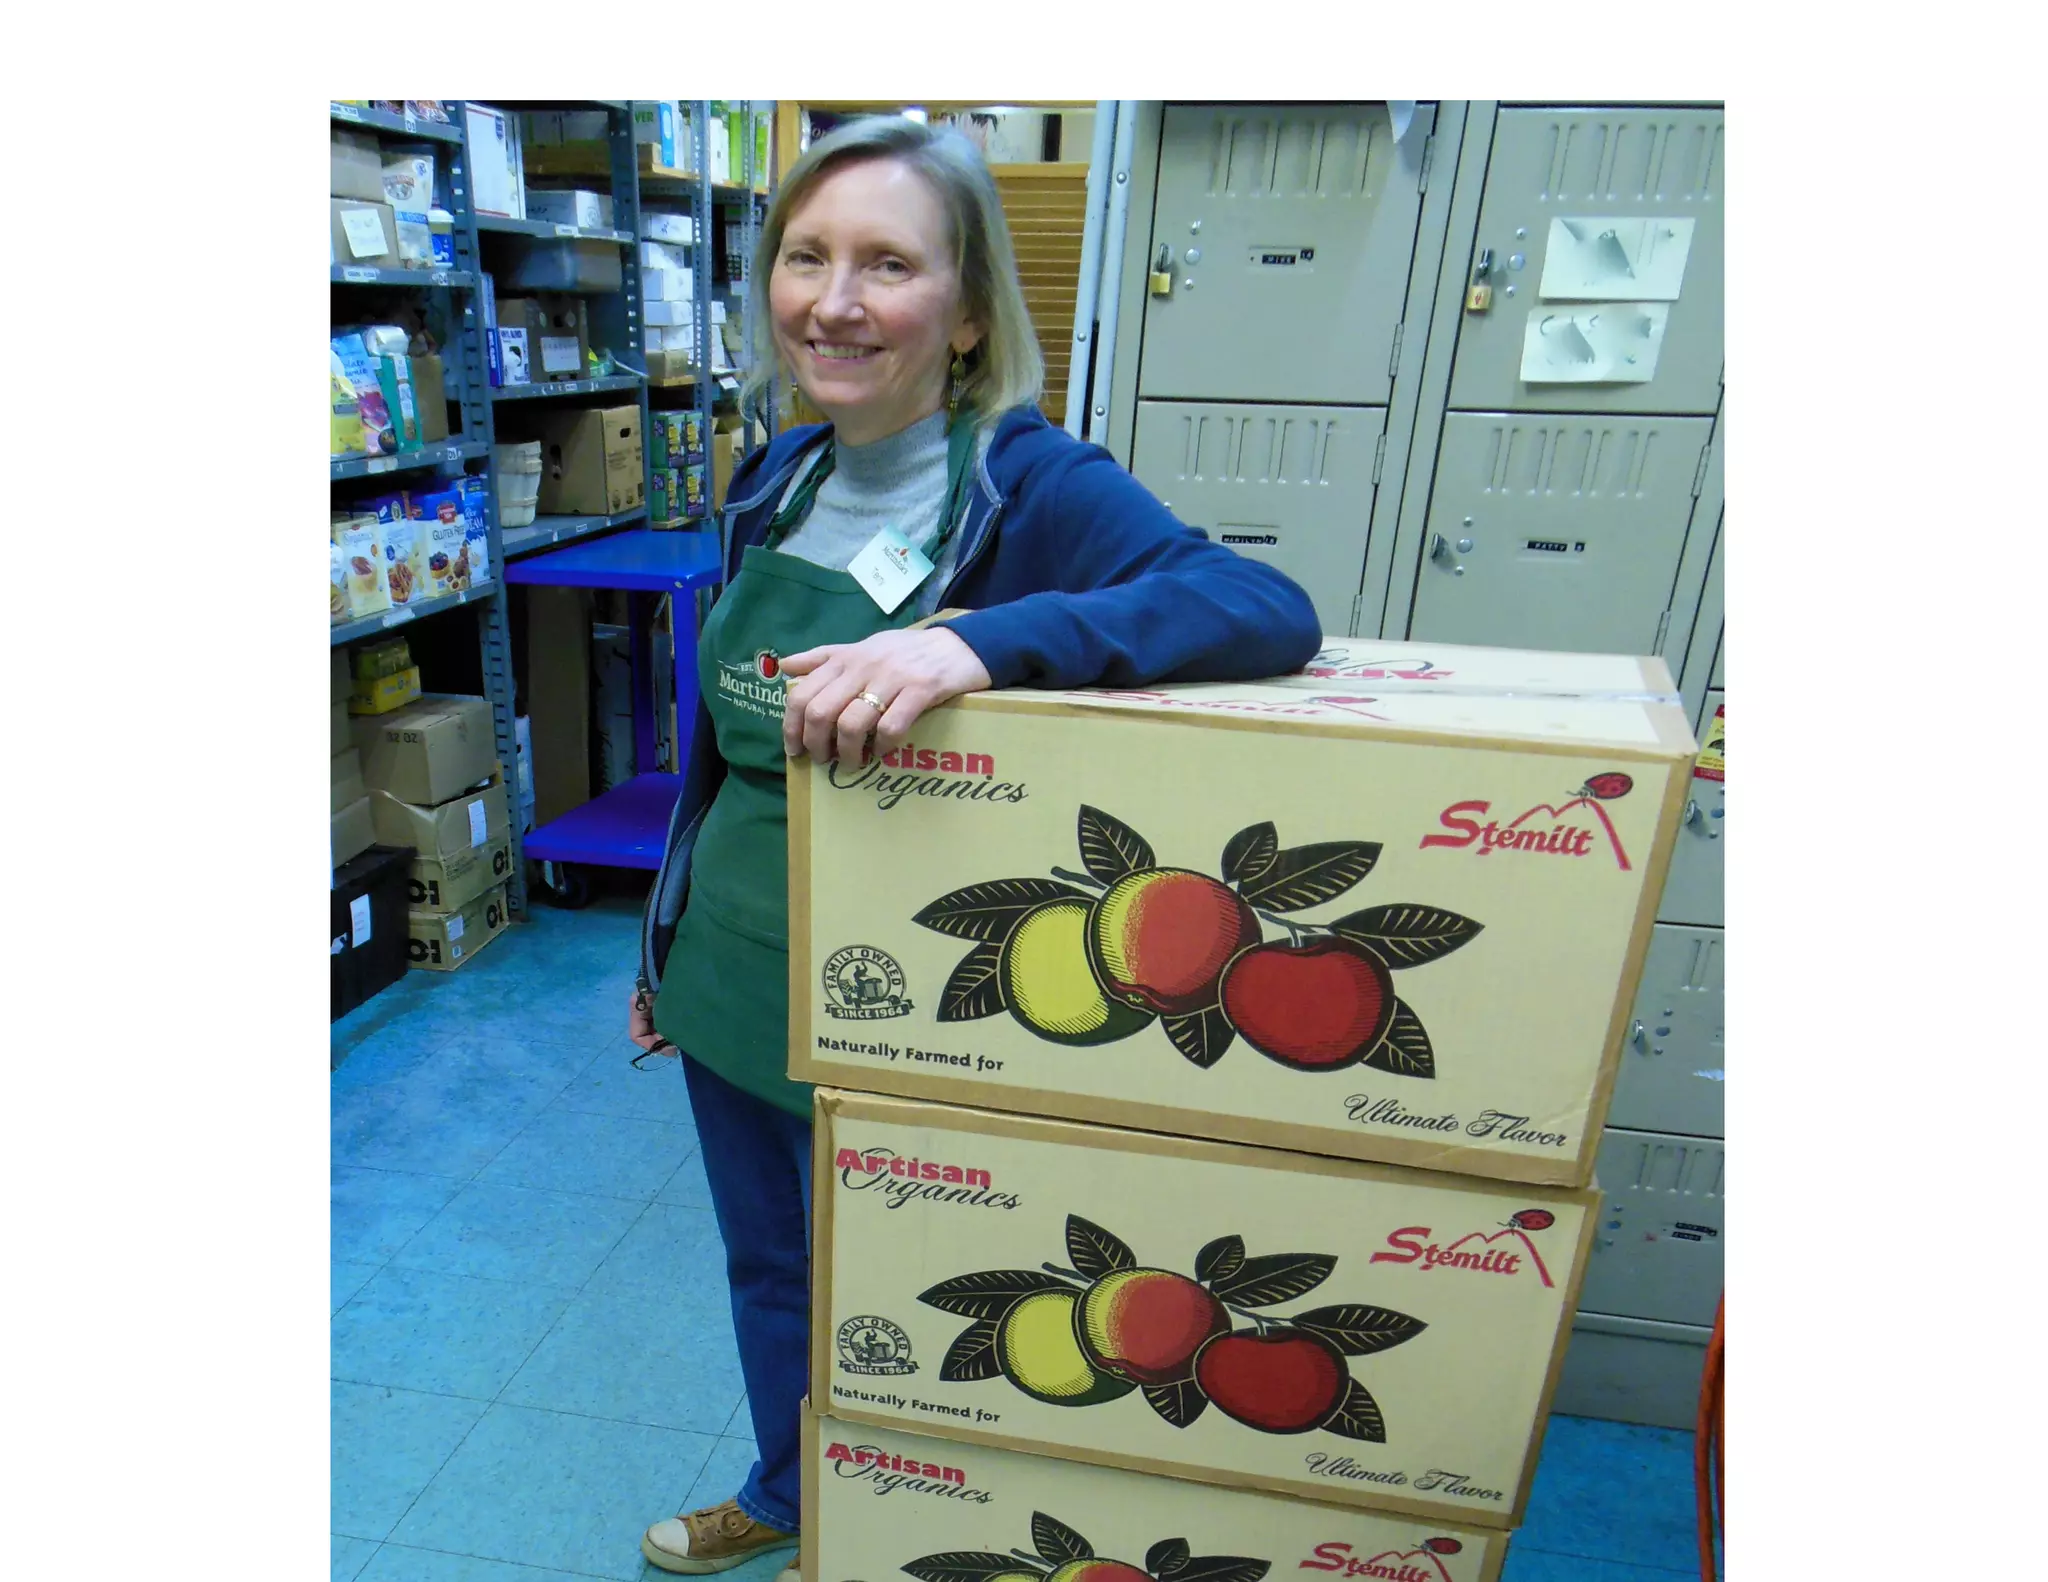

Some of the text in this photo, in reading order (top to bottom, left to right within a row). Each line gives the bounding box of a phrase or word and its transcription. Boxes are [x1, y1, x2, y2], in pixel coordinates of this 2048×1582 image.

[733, 697, 766, 718] NATURAL
[862, 743, 995, 776] tisan
[1418, 799, 1594, 857] Stemilt
[827, 948, 902, 989] FAMILY OWNED
[836, 1006, 904, 1019] SINCE 1964
[818, 1036, 1005, 1072] Naturally Farmed for
[1343, 1093, 1568, 1147] Ultimate Flavor
[836, 1147, 992, 1187] Artisan
[841, 1147, 1023, 1210] Organics
[1369, 1226, 1522, 1275] Stemilt
[840, 1318, 908, 1350] FAMILY OWNED
[849, 1366, 910, 1375] SINCE 1964
[833, 1385, 1001, 1423] Naturally Farmed for
[824, 1442, 966, 1485] Artisan
[834, 1444, 994, 1504] Organics
[1305, 1452, 1504, 1501] Ultimate Flavor
[1299, 1541, 1432, 1582] Stemilt
